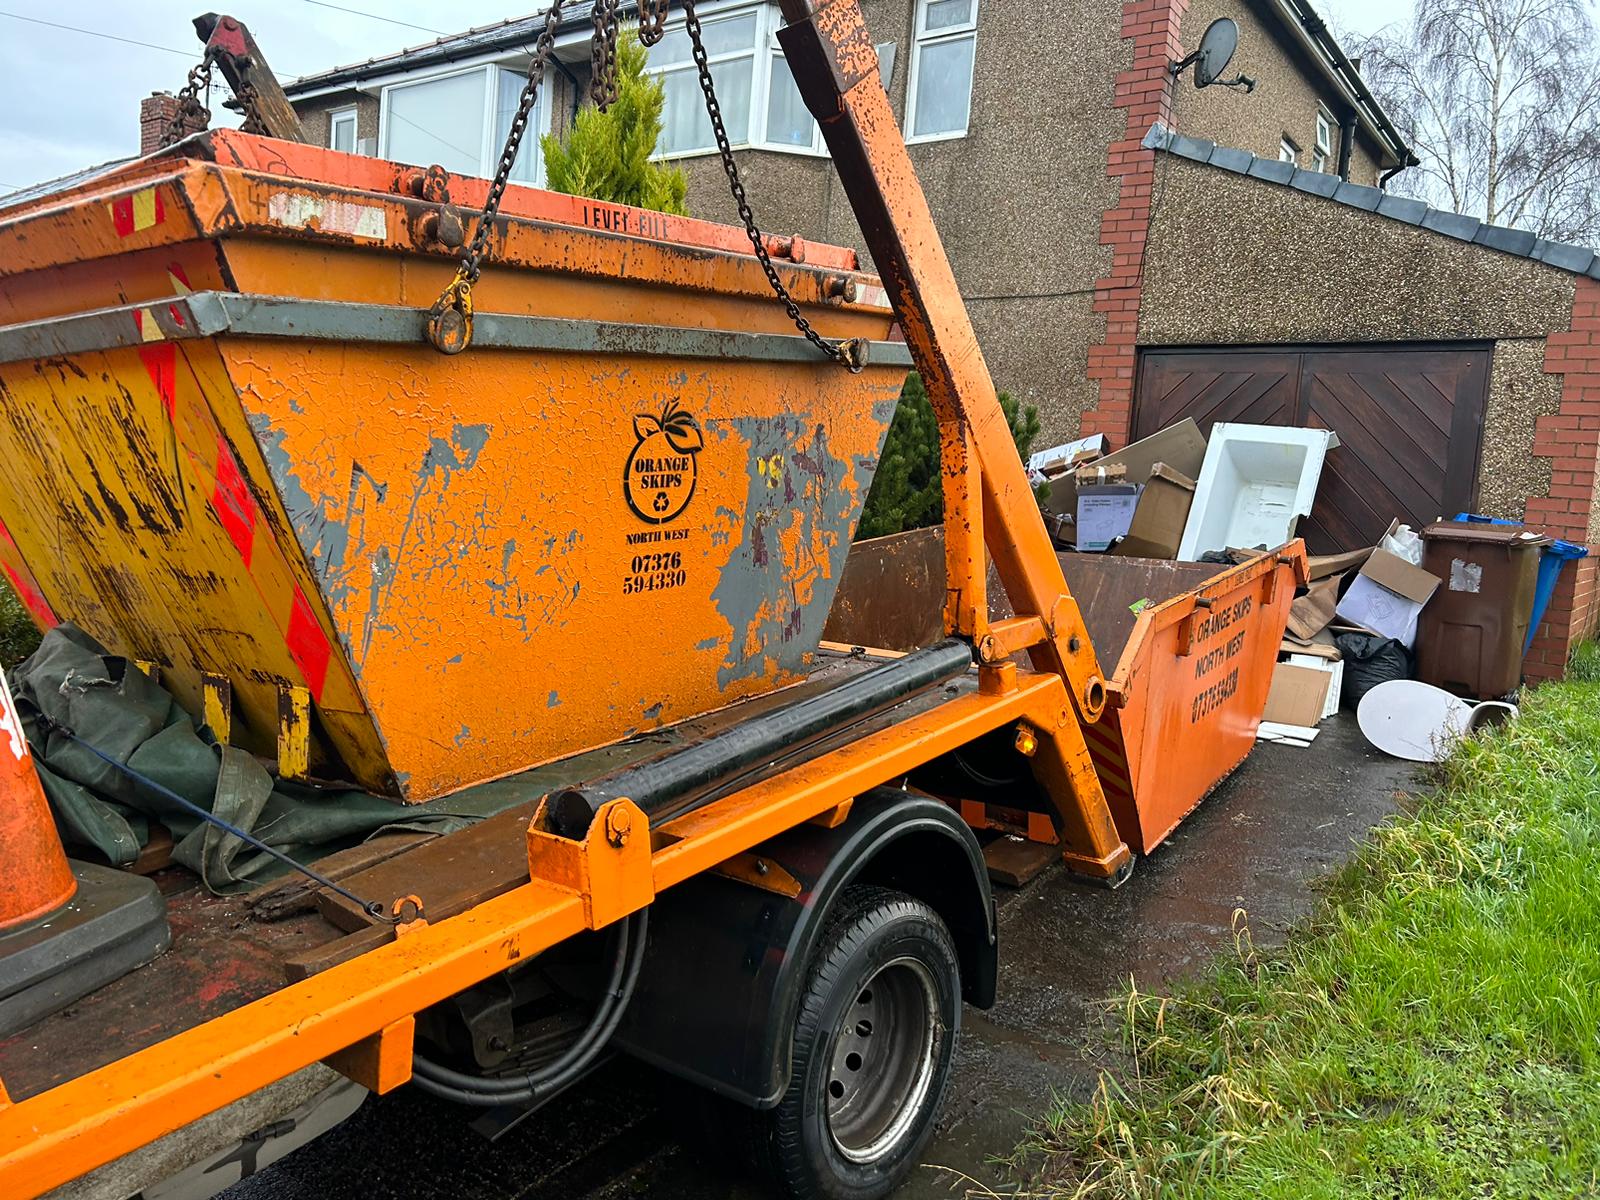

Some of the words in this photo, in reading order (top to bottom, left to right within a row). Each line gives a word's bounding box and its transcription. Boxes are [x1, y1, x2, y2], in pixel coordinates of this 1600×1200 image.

[635, 457, 689, 473] ORANGE
[641, 474, 682, 489] SKIPS
[626, 531, 661, 545] NORTH
[664, 529, 690, 541] WEST
[631, 551, 681, 574] 07376
[623, 569, 686, 595] 594330
[1197, 606, 1231, 643] ORANGE
[1232, 594, 1252, 622] SKIPS
[1195, 644, 1225, 680] NORTH
[1226, 630, 1245, 660] WEST
